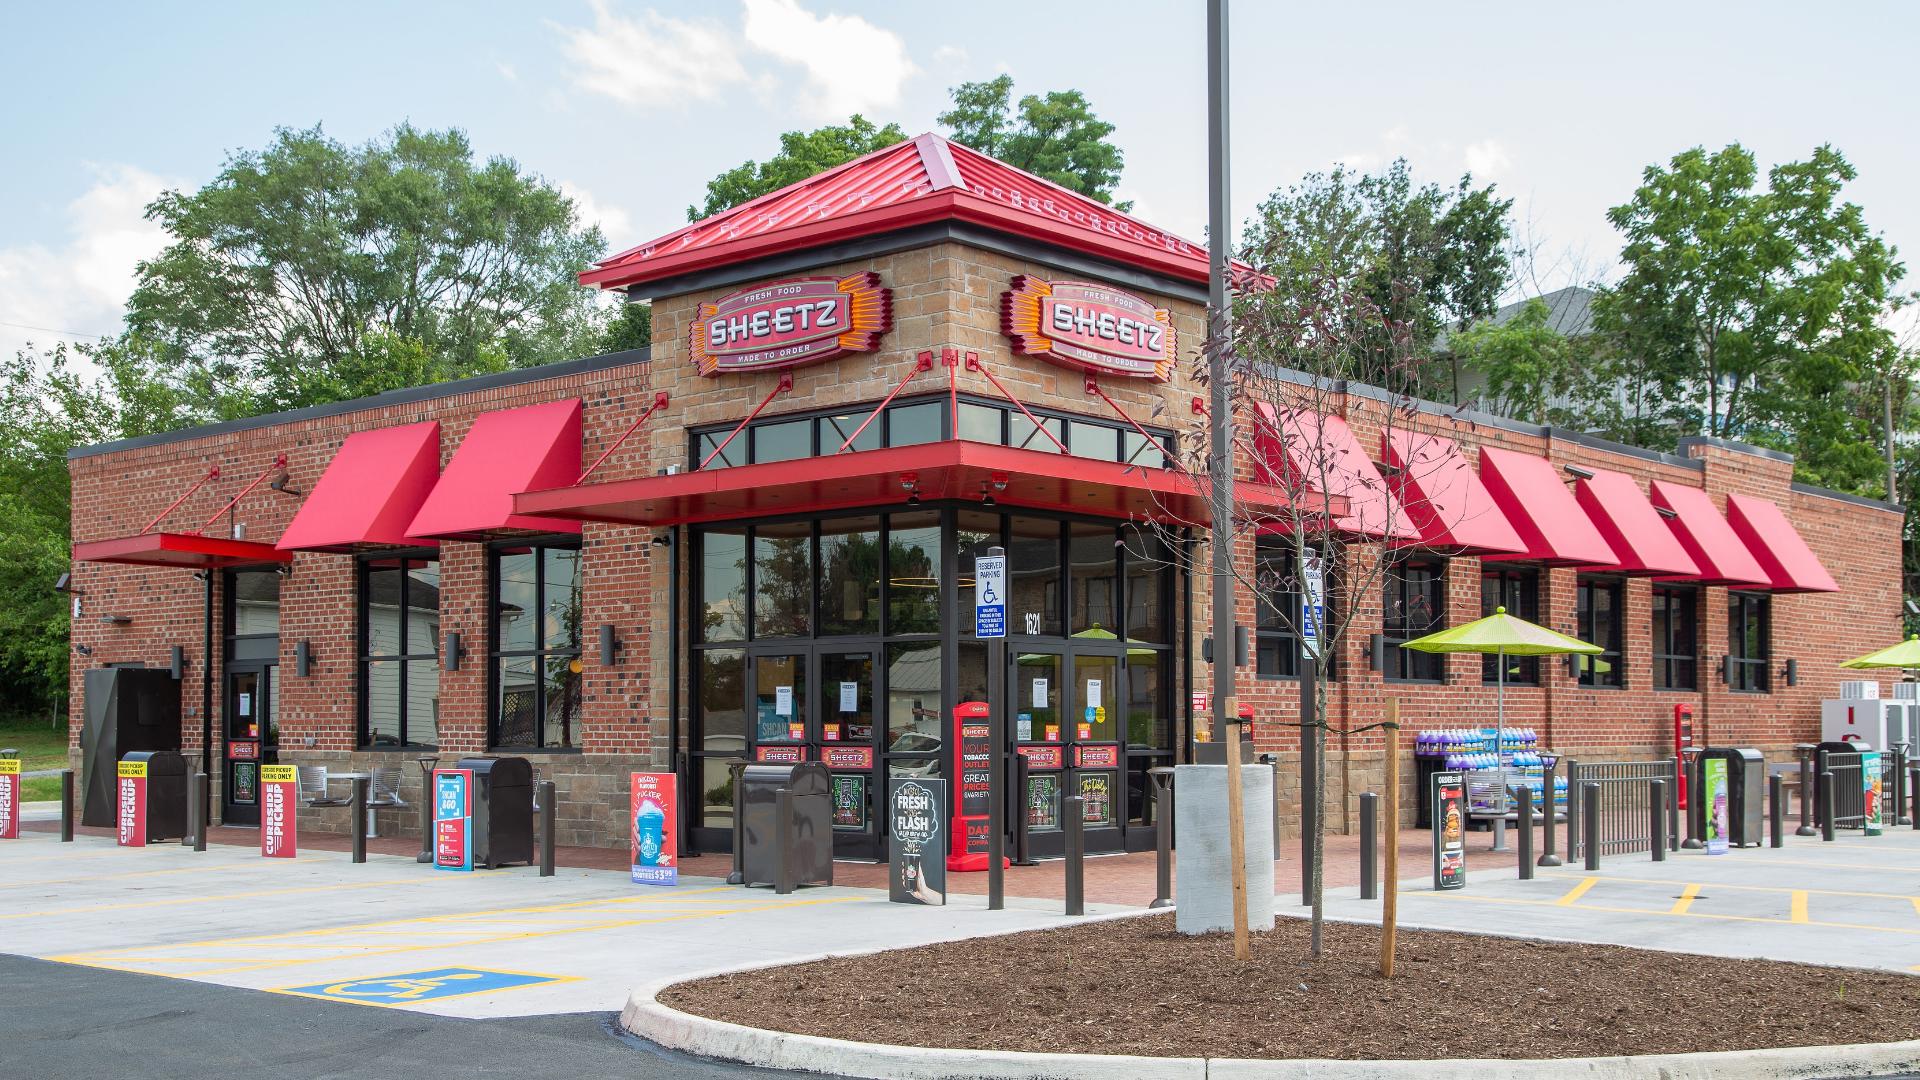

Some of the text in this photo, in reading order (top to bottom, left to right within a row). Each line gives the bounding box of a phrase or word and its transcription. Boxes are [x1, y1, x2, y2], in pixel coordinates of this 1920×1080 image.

[745, 286, 802, 304] FRESH FOOD
[1084, 291, 1133, 309] FRESH FOOD
[711, 300, 838, 347] SHEETZ
[1053, 303, 1163, 352] SHEETZ
[738, 344, 810, 362] MADE TO ORDER
[1076, 348, 1097, 360] MADE
[1115, 357, 1138, 368] ORDER
[979, 561, 1003, 570] RESERVED
[1025, 612, 1040, 635] 1621
[965, 744, 989, 754] YOUR
[1027, 753, 1054, 761] SHEETZ
[964, 773, 989, 783] GREAT
[127, 779, 135, 827] PICKUP
[637, 790, 662, 800] PUCKER
[898, 795, 928, 810] FRESH
[273, 783, 283, 836] PICKUP
[266, 784, 274, 854] CURBSIDE
[898, 816, 929, 831] FLASH
[968, 826, 989, 836] DAR
